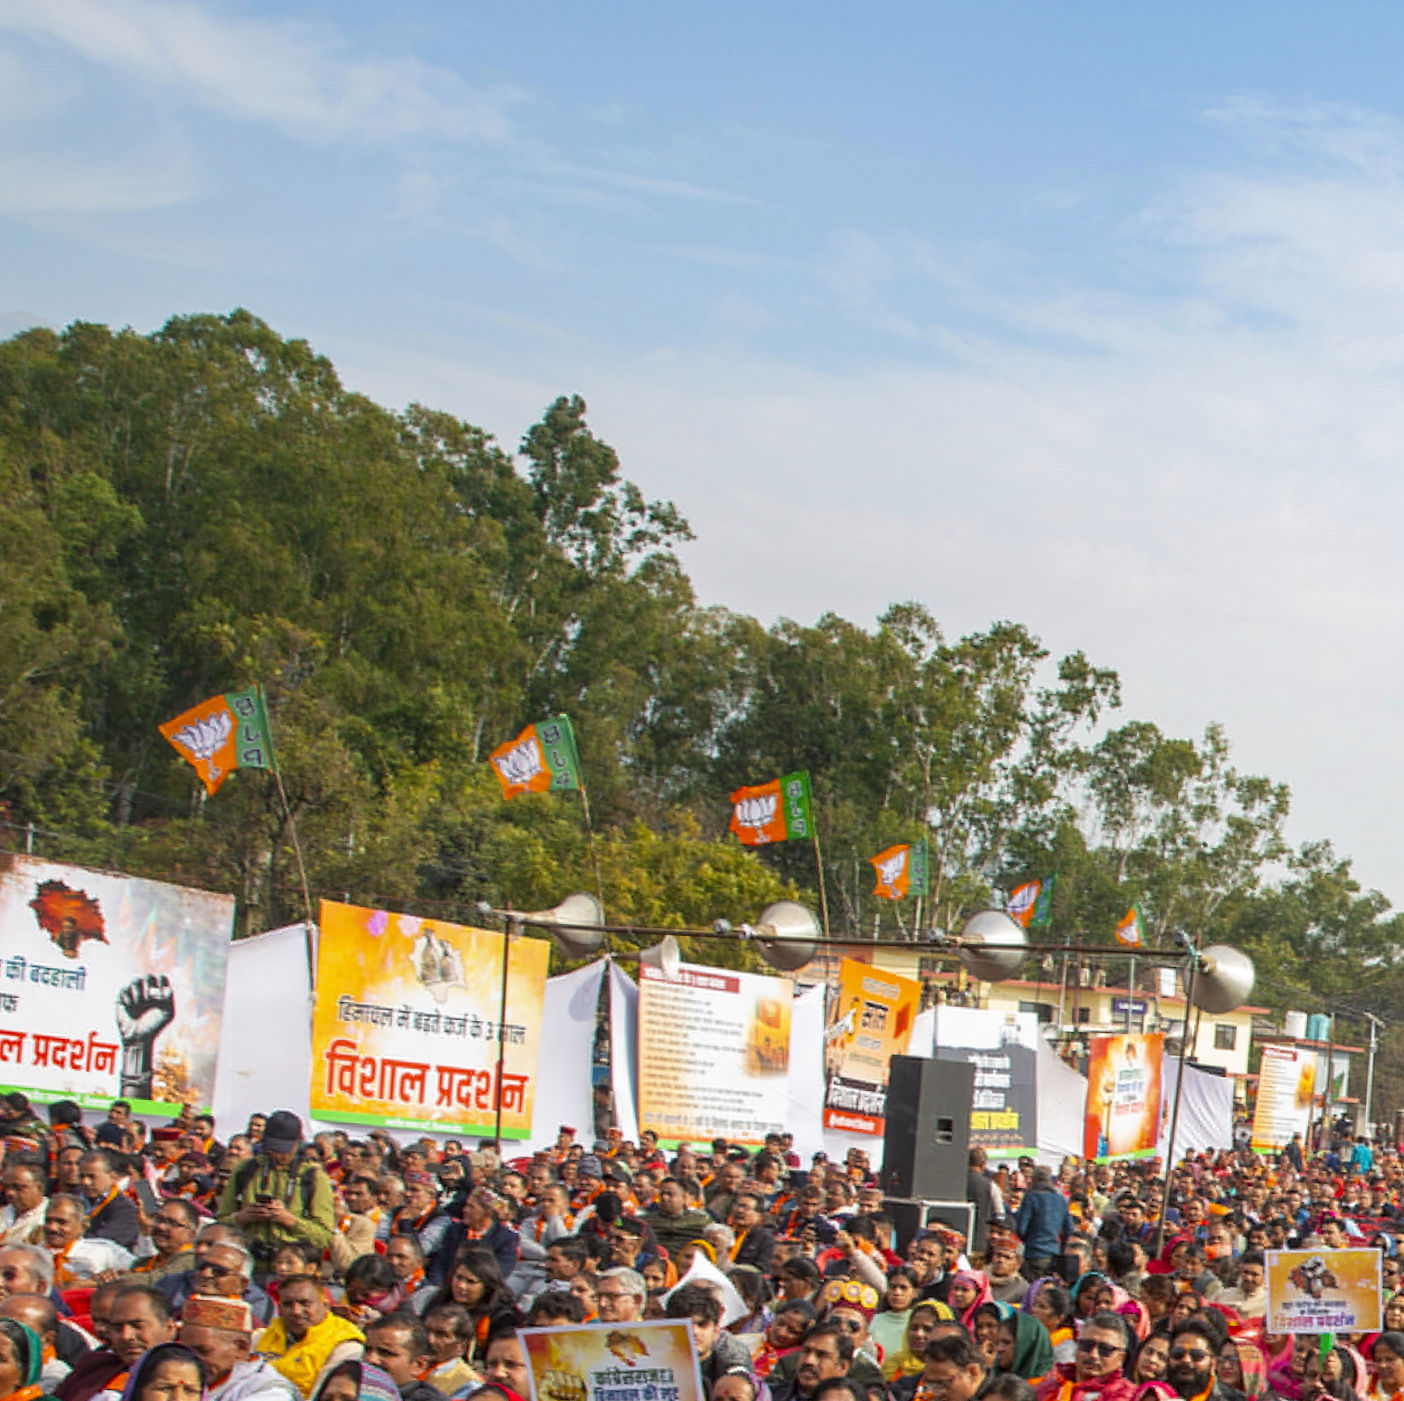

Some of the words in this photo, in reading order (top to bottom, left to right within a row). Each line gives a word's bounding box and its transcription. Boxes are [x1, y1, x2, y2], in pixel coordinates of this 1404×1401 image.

[32, 1031, 119, 1075] प्रदर्शन
[325, 1039, 430, 1104] विशाल
[435, 1059, 529, 1114] प्रदर्शन
